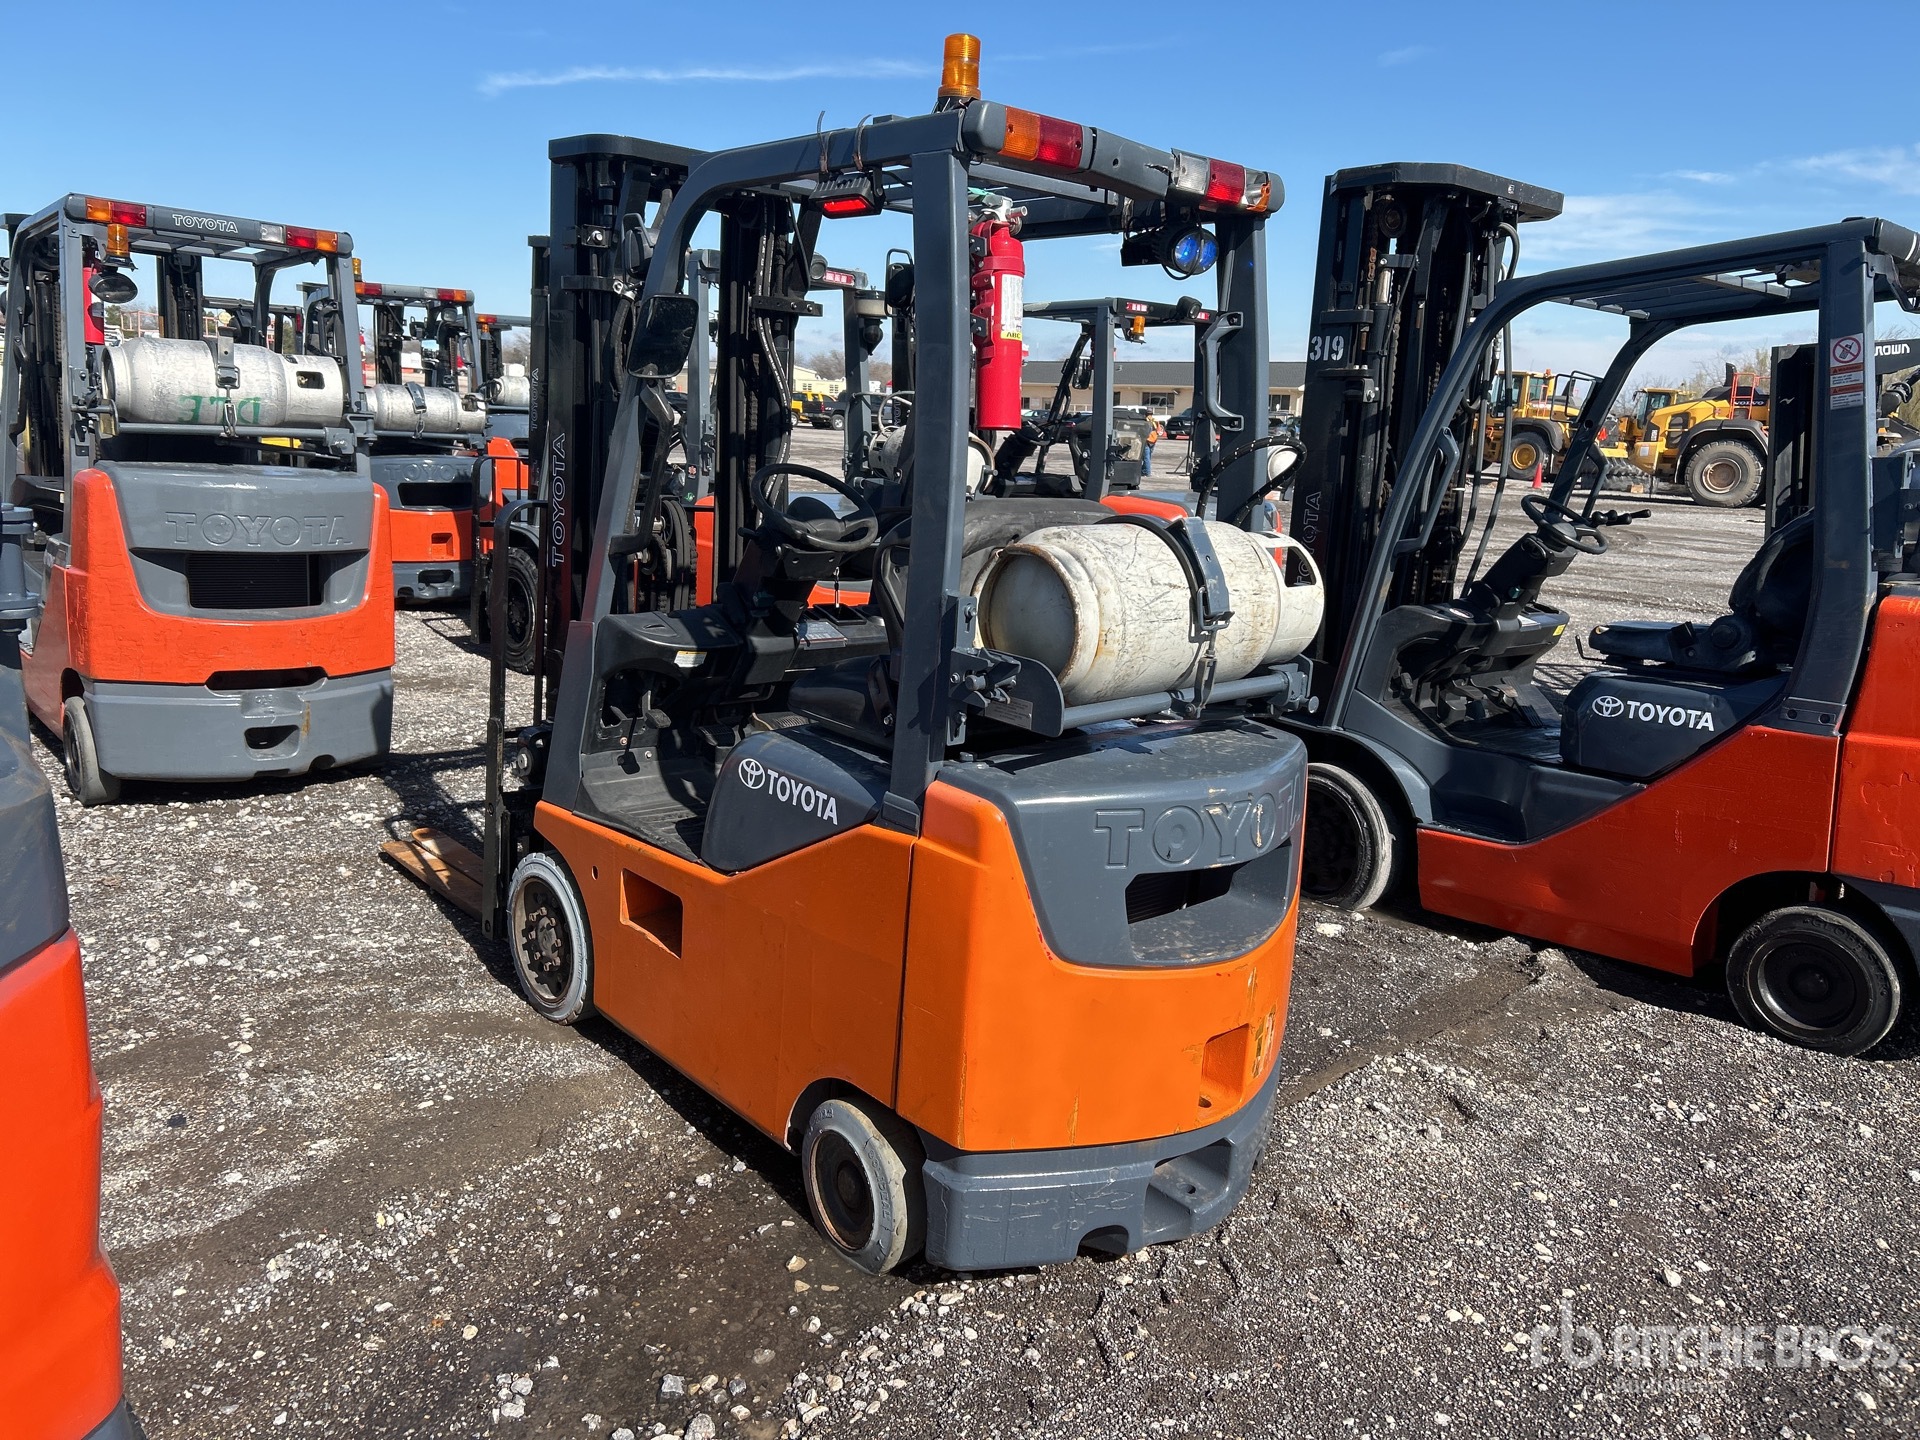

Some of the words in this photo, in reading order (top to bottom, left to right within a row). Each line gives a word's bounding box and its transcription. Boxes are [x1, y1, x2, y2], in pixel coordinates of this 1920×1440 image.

[172, 213, 238, 233] TOYOTA
[1310, 335, 1345, 361] 319
[552, 432, 566, 568] TOYOTA
[164, 511, 354, 546] TOYOTA
[1626, 700, 1715, 732] TOYOTA
[767, 768, 838, 826] TOYOTA
